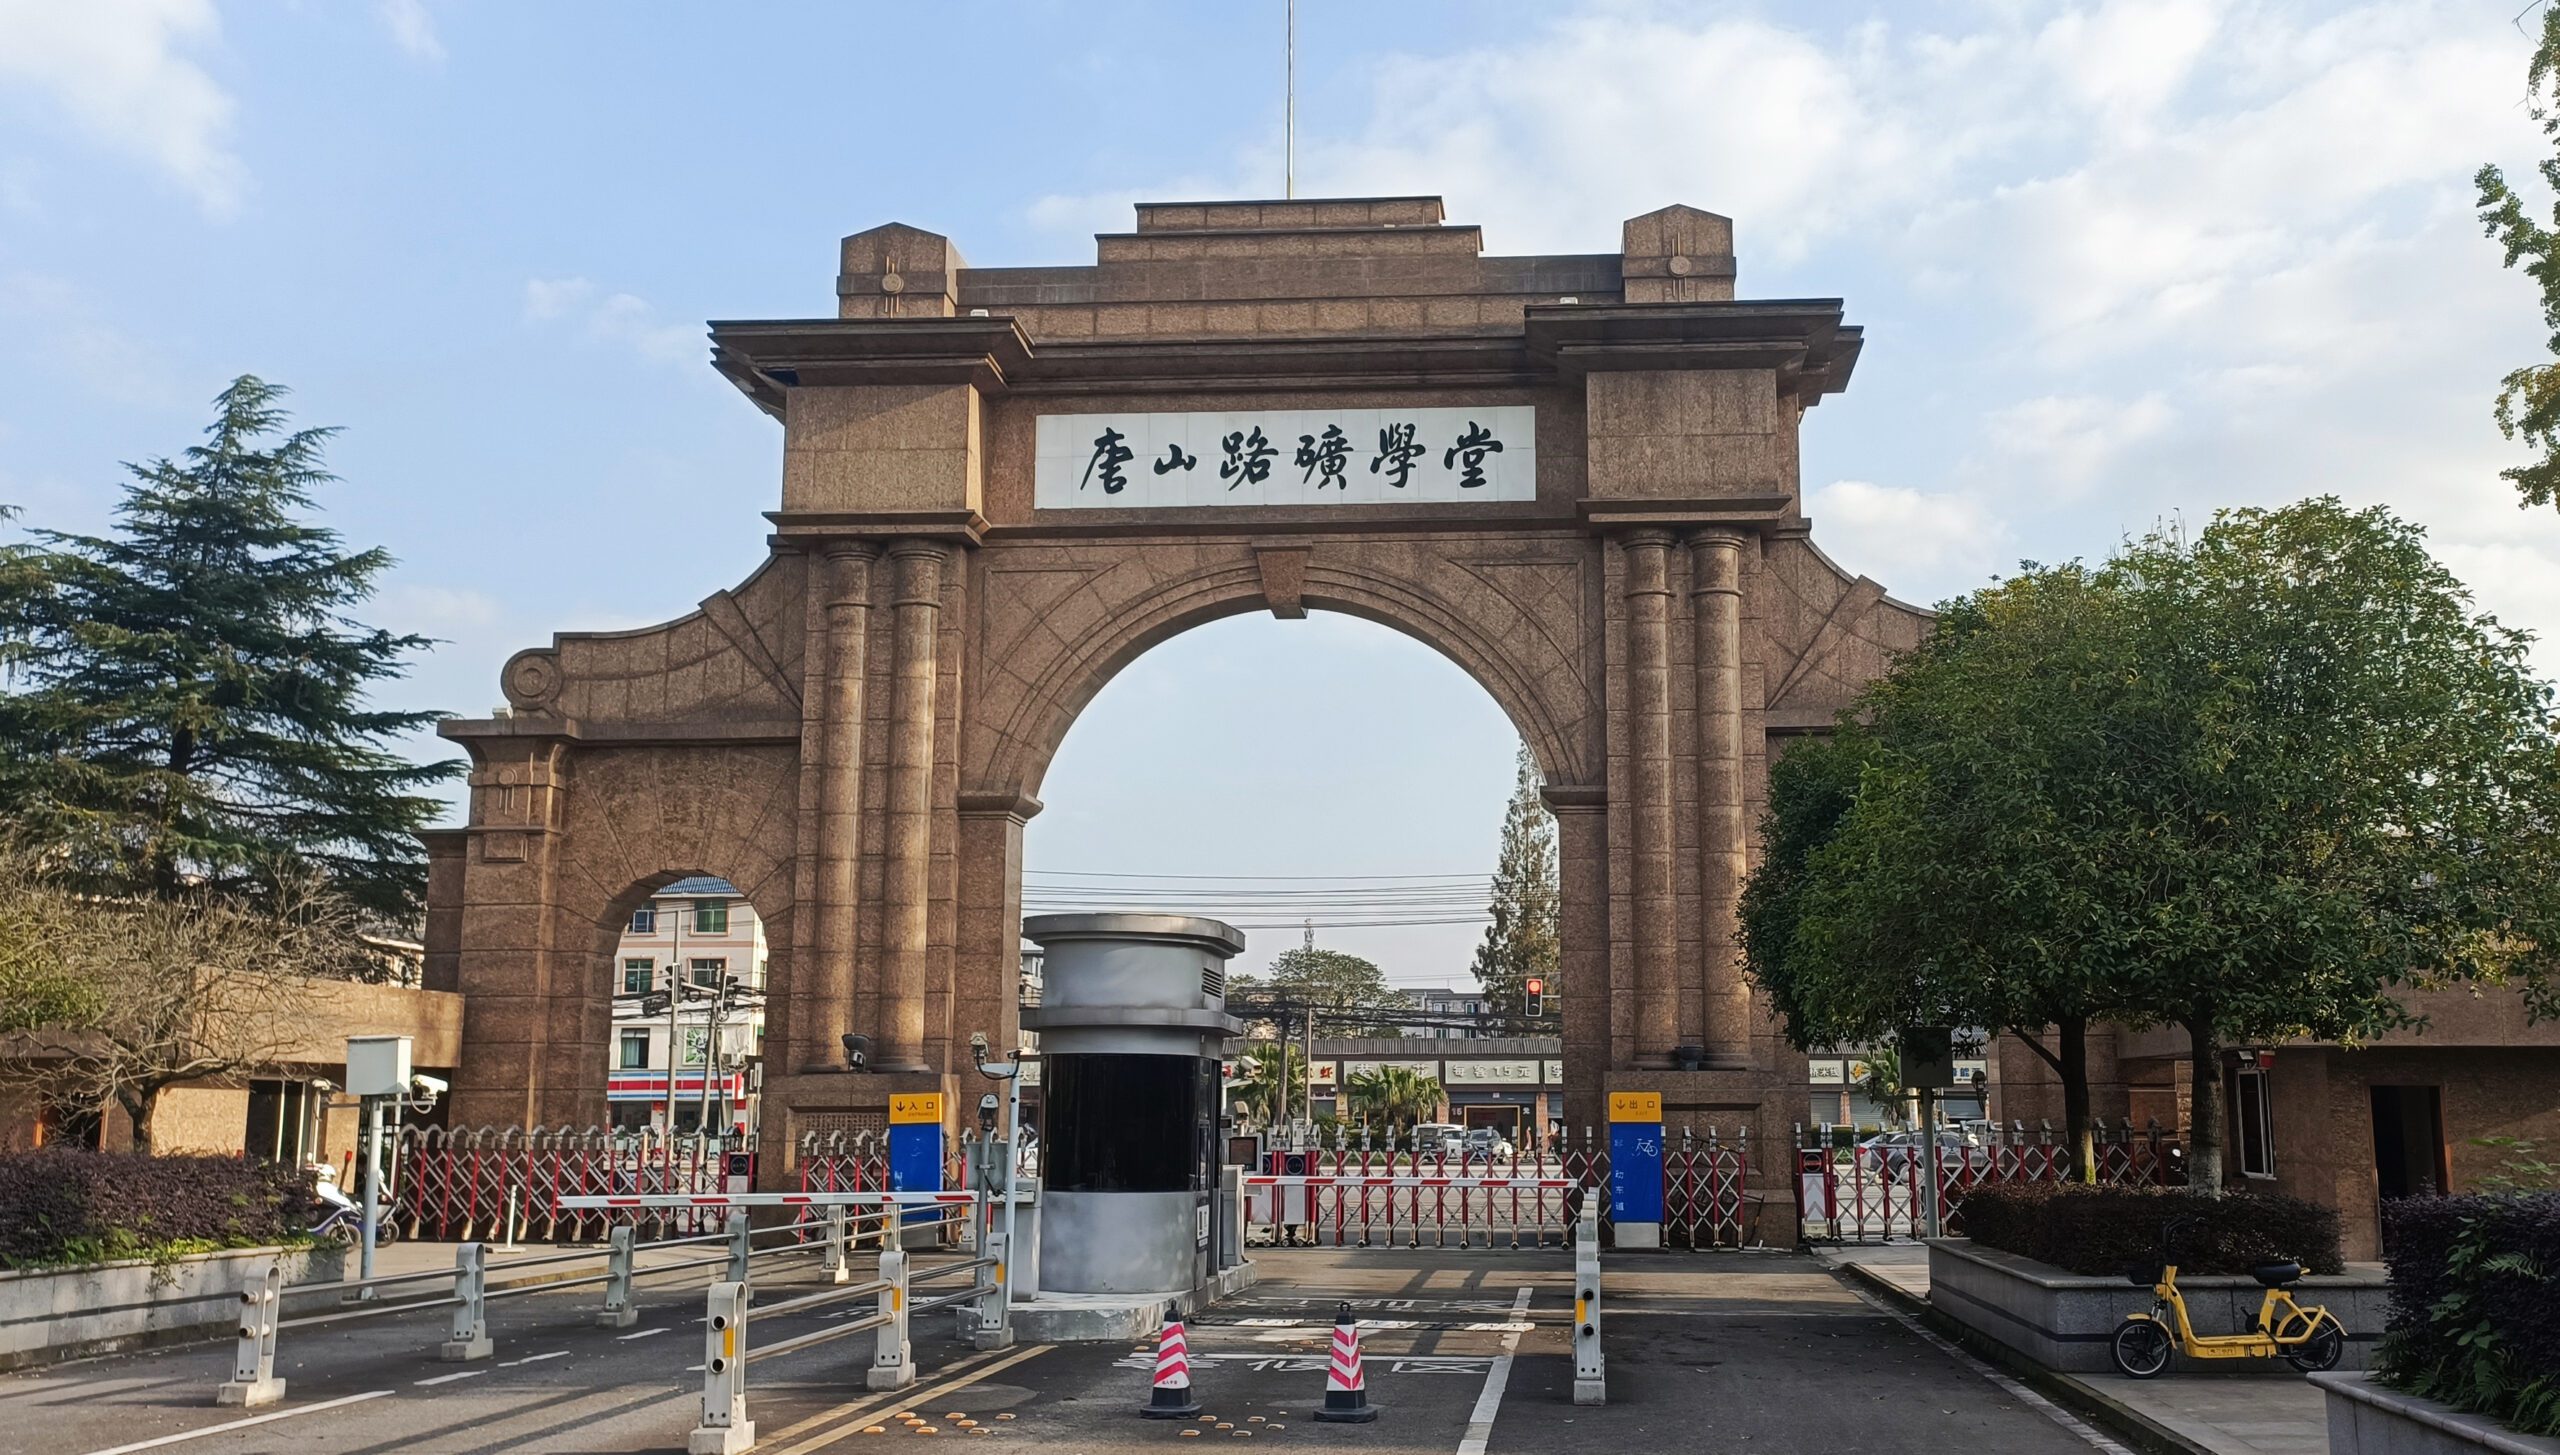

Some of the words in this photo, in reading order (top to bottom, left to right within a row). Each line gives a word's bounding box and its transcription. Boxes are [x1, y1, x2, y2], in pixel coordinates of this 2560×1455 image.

[1080, 420, 1504, 495] 唐山路礦學堂
[908, 1101, 935, 1111] 入口
[1628, 1099, 1655, 1110] 出口
